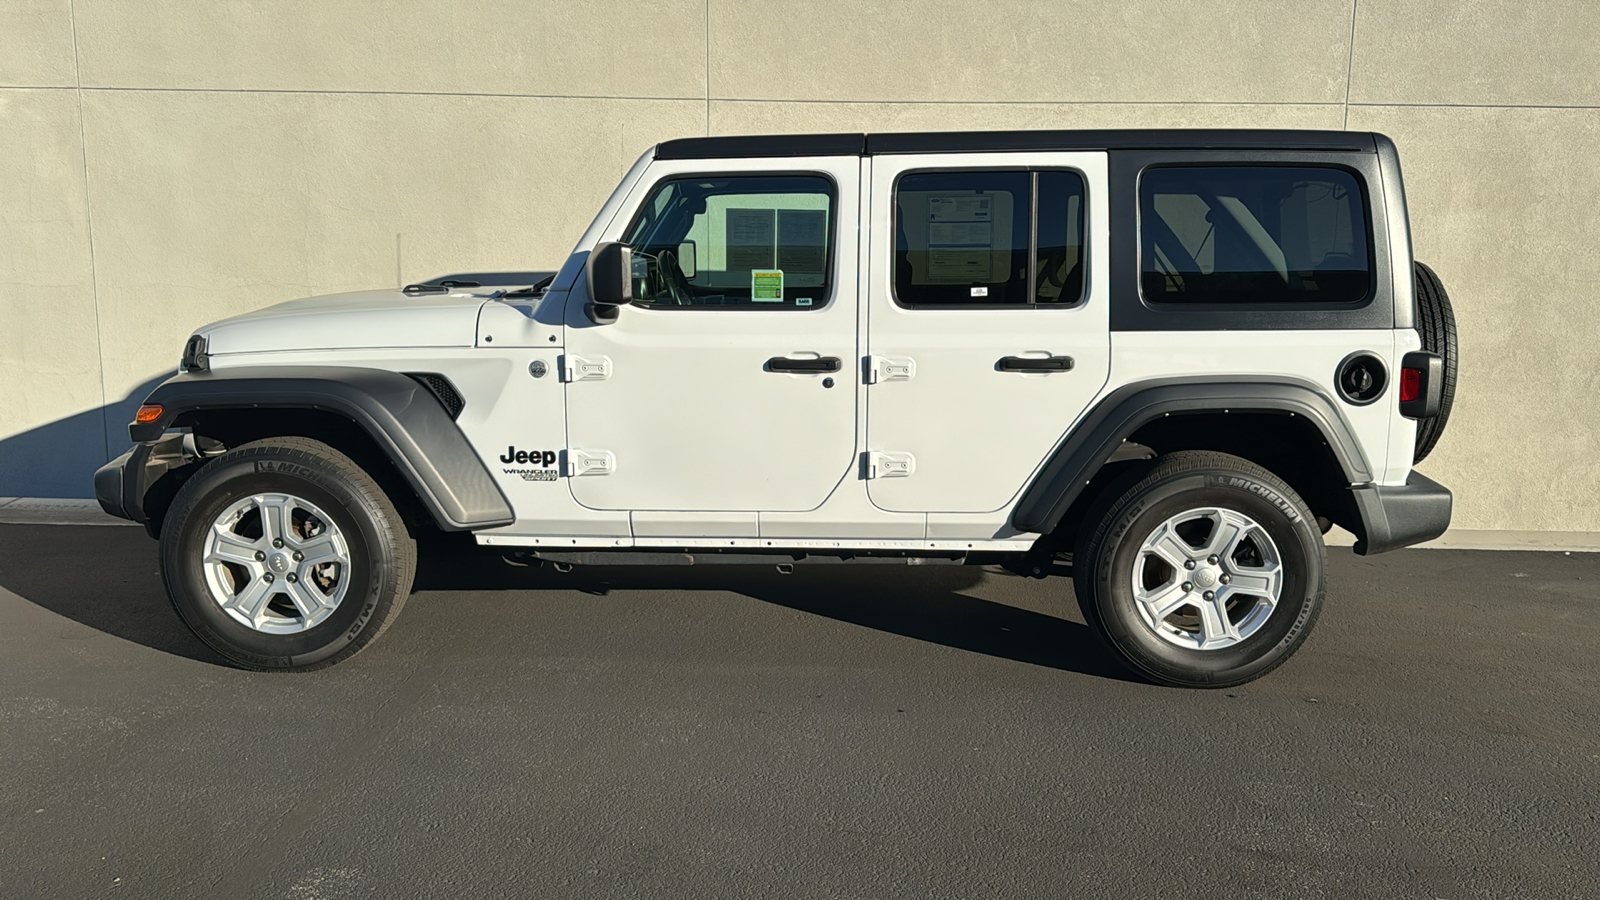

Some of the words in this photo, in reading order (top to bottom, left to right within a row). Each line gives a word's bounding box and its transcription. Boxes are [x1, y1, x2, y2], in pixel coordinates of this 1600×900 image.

[500, 446, 556, 468] Jeep
[1228, 477, 1298, 518] MICHELIN
[1101, 544, 1115, 582] LTX
